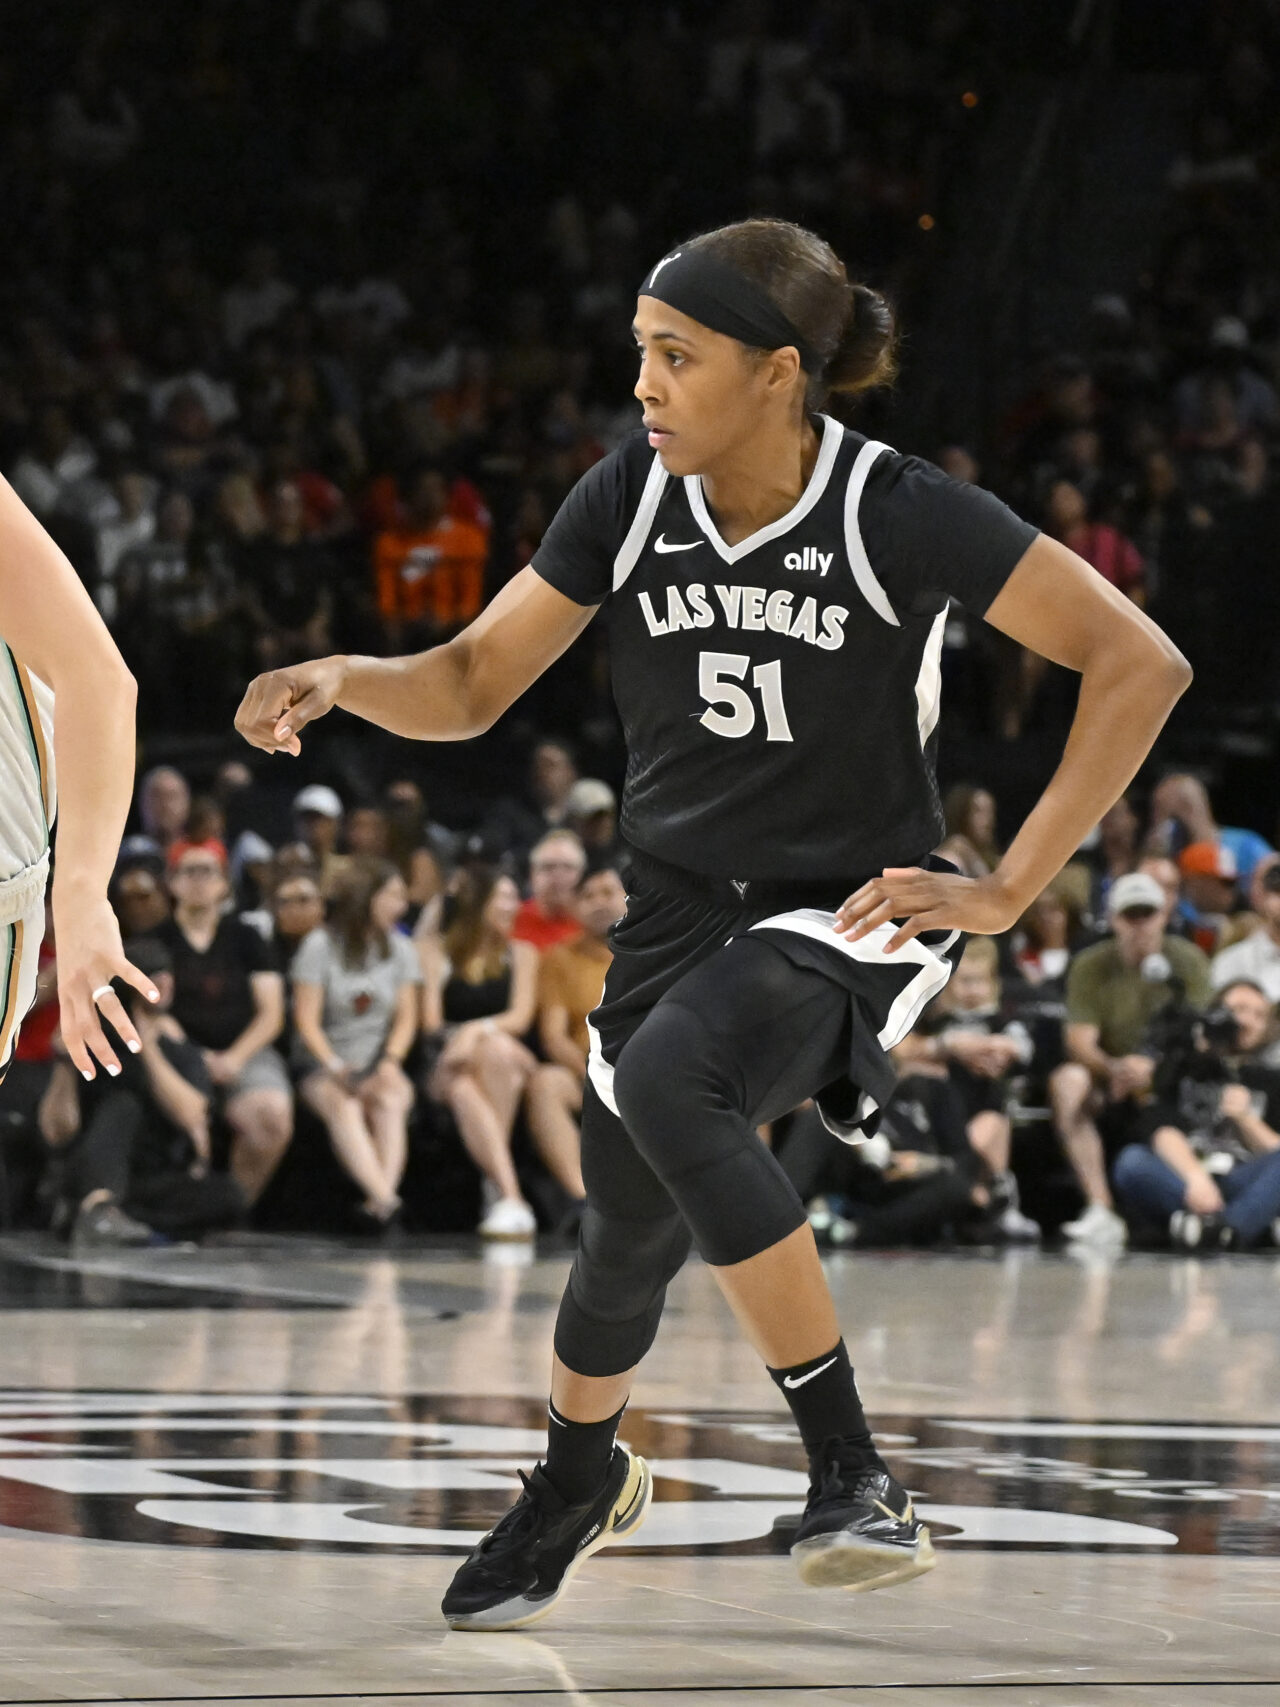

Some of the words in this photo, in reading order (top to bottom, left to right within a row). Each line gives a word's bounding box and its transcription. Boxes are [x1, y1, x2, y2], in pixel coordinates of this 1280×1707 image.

[784, 547, 834, 576] ally
[637, 583, 716, 637] LAS
[714, 584, 850, 651] VEGAS
[698, 651, 794, 742] 51
